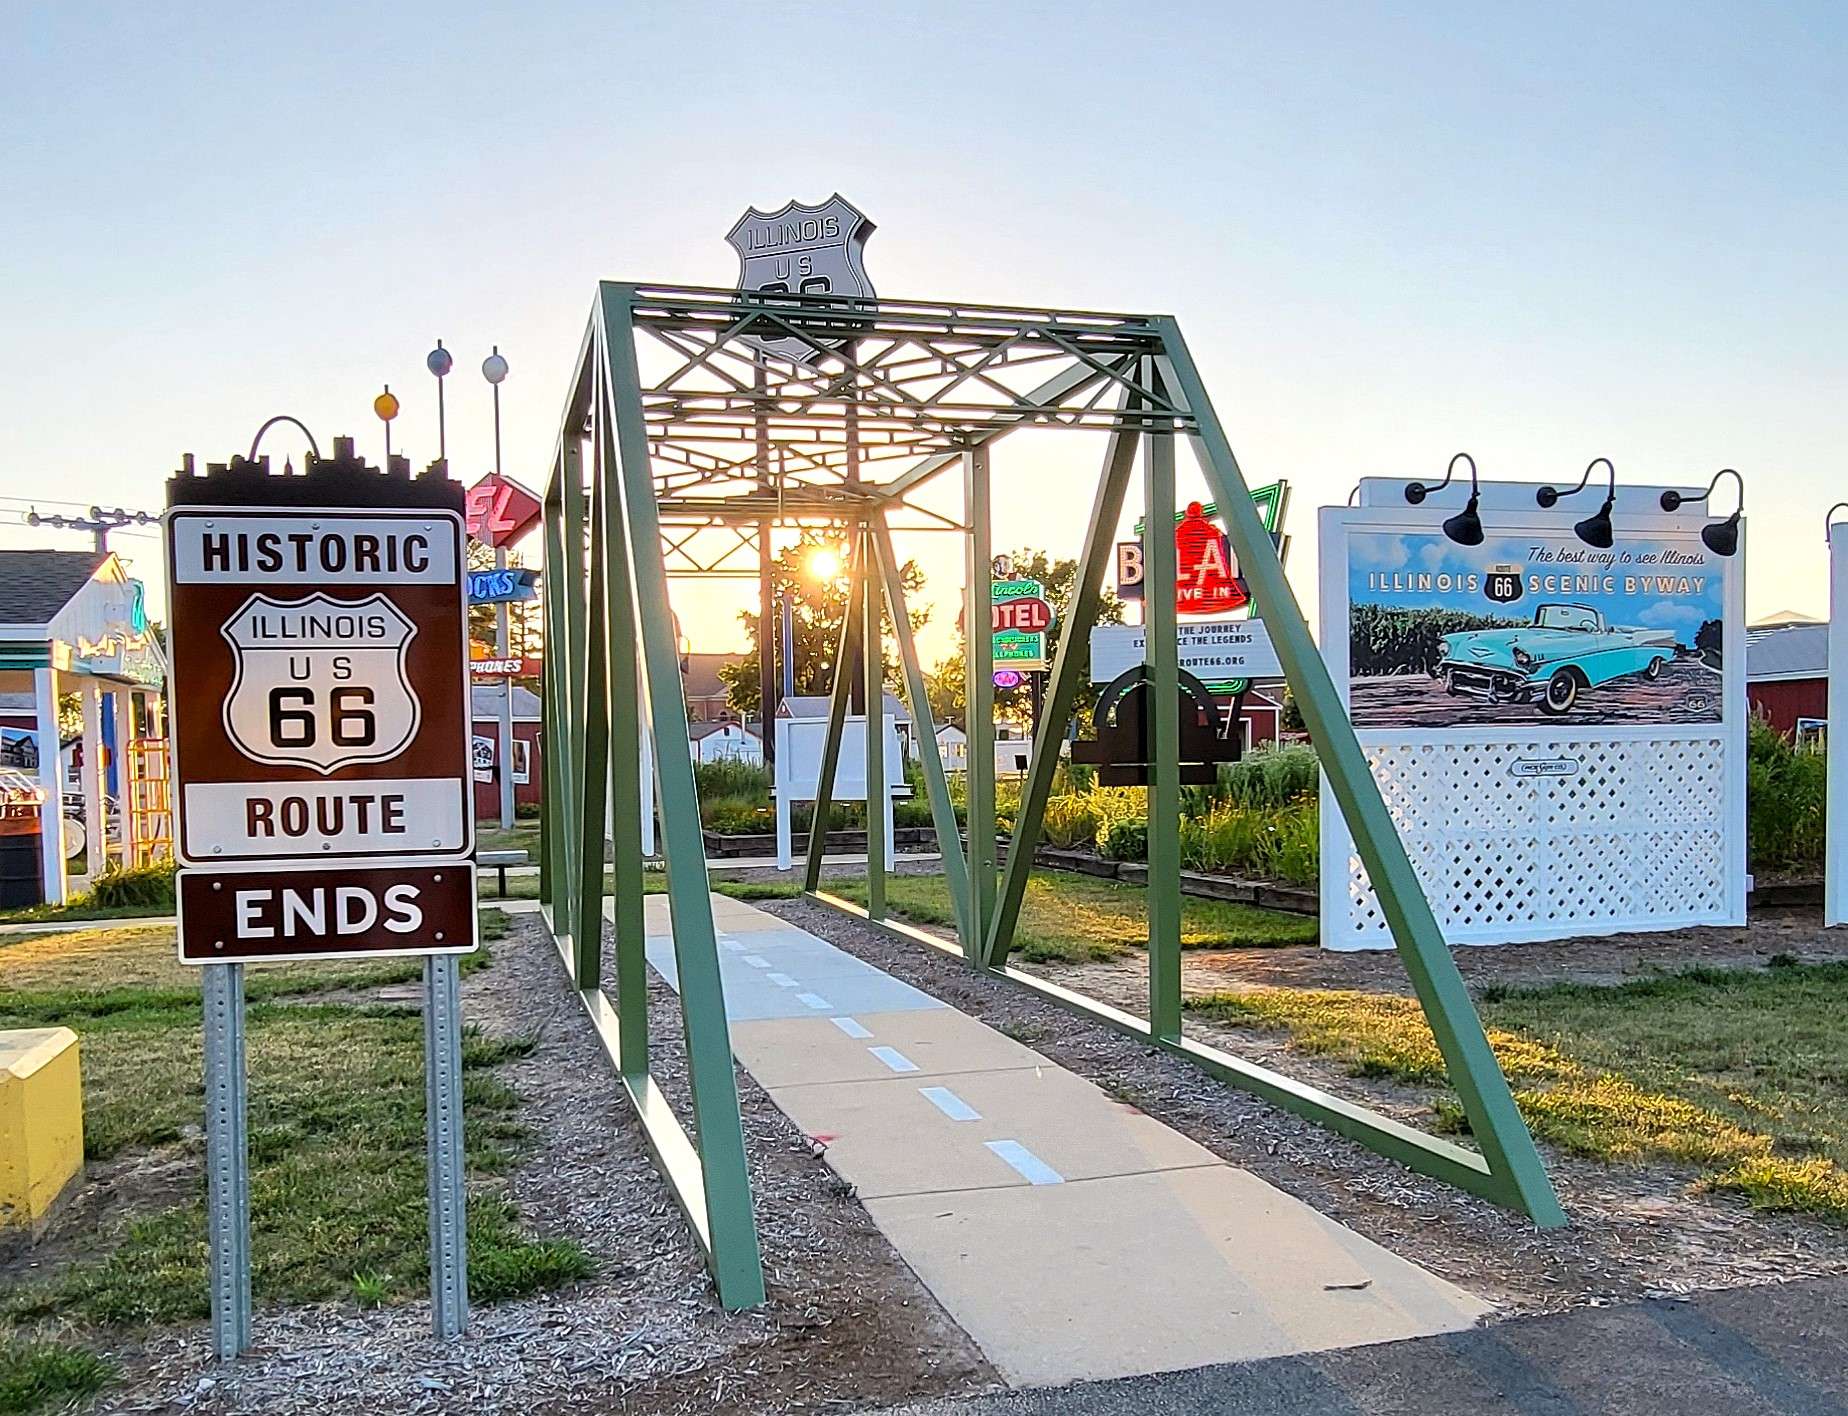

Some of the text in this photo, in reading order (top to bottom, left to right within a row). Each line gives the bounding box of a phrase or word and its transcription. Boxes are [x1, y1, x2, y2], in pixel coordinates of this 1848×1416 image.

[748, 216, 840, 251] ILLINOIS
[775, 255, 813, 280] U S
[202, 532, 430, 573] HISTORIC
[1528, 547, 1705, 571] The best way to see Illinois
[1368, 572, 1706, 597] ILLINOIS 66 SCENIC BYWAY
[251, 615, 387, 640] ILLINOIS
[1178, 624, 1241, 635] THE JOURNEY
[1192, 636, 1209, 645] THE
[1211, 634, 1253, 644] LEGENDS
[289, 655, 352, 681] U S
[1689, 700, 1705, 708] 66
[268, 686, 376, 749] 66
[246, 793, 407, 838] ROUTE
[235, 884, 424, 939] ENDS
